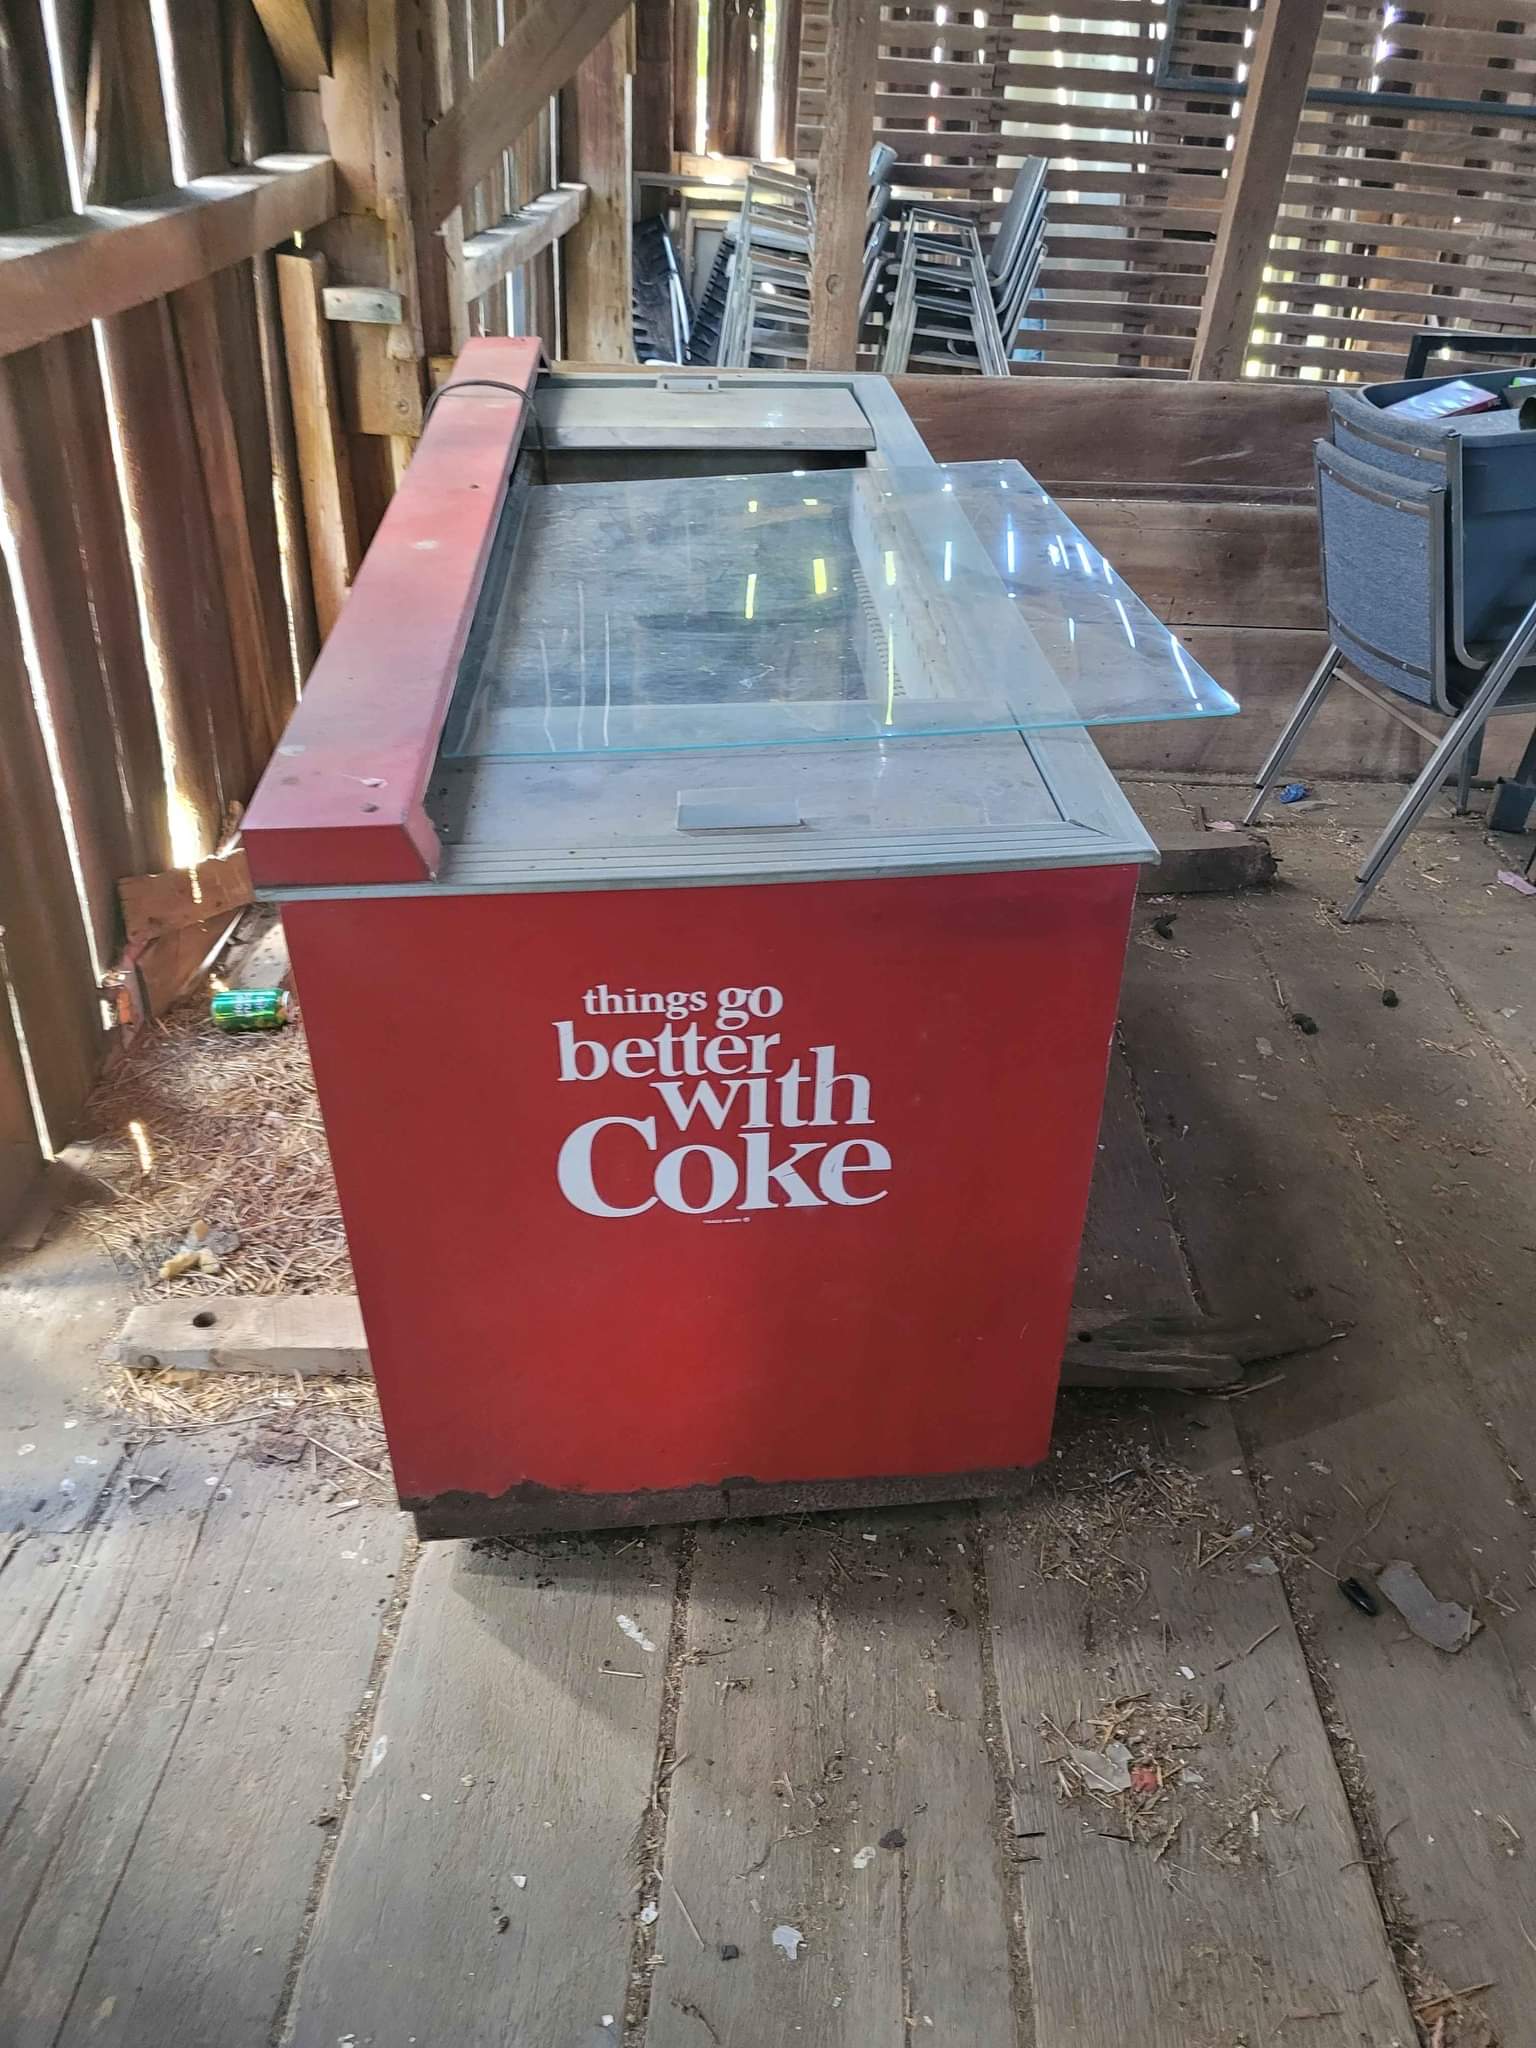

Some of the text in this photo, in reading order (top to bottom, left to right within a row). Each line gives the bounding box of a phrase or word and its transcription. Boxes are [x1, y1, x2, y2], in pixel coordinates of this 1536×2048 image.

[582, 984, 784, 1031] things go
[551, 1020, 782, 1082] better
[649, 1045, 875, 1131] with
[557, 1116, 893, 1218] Coke
